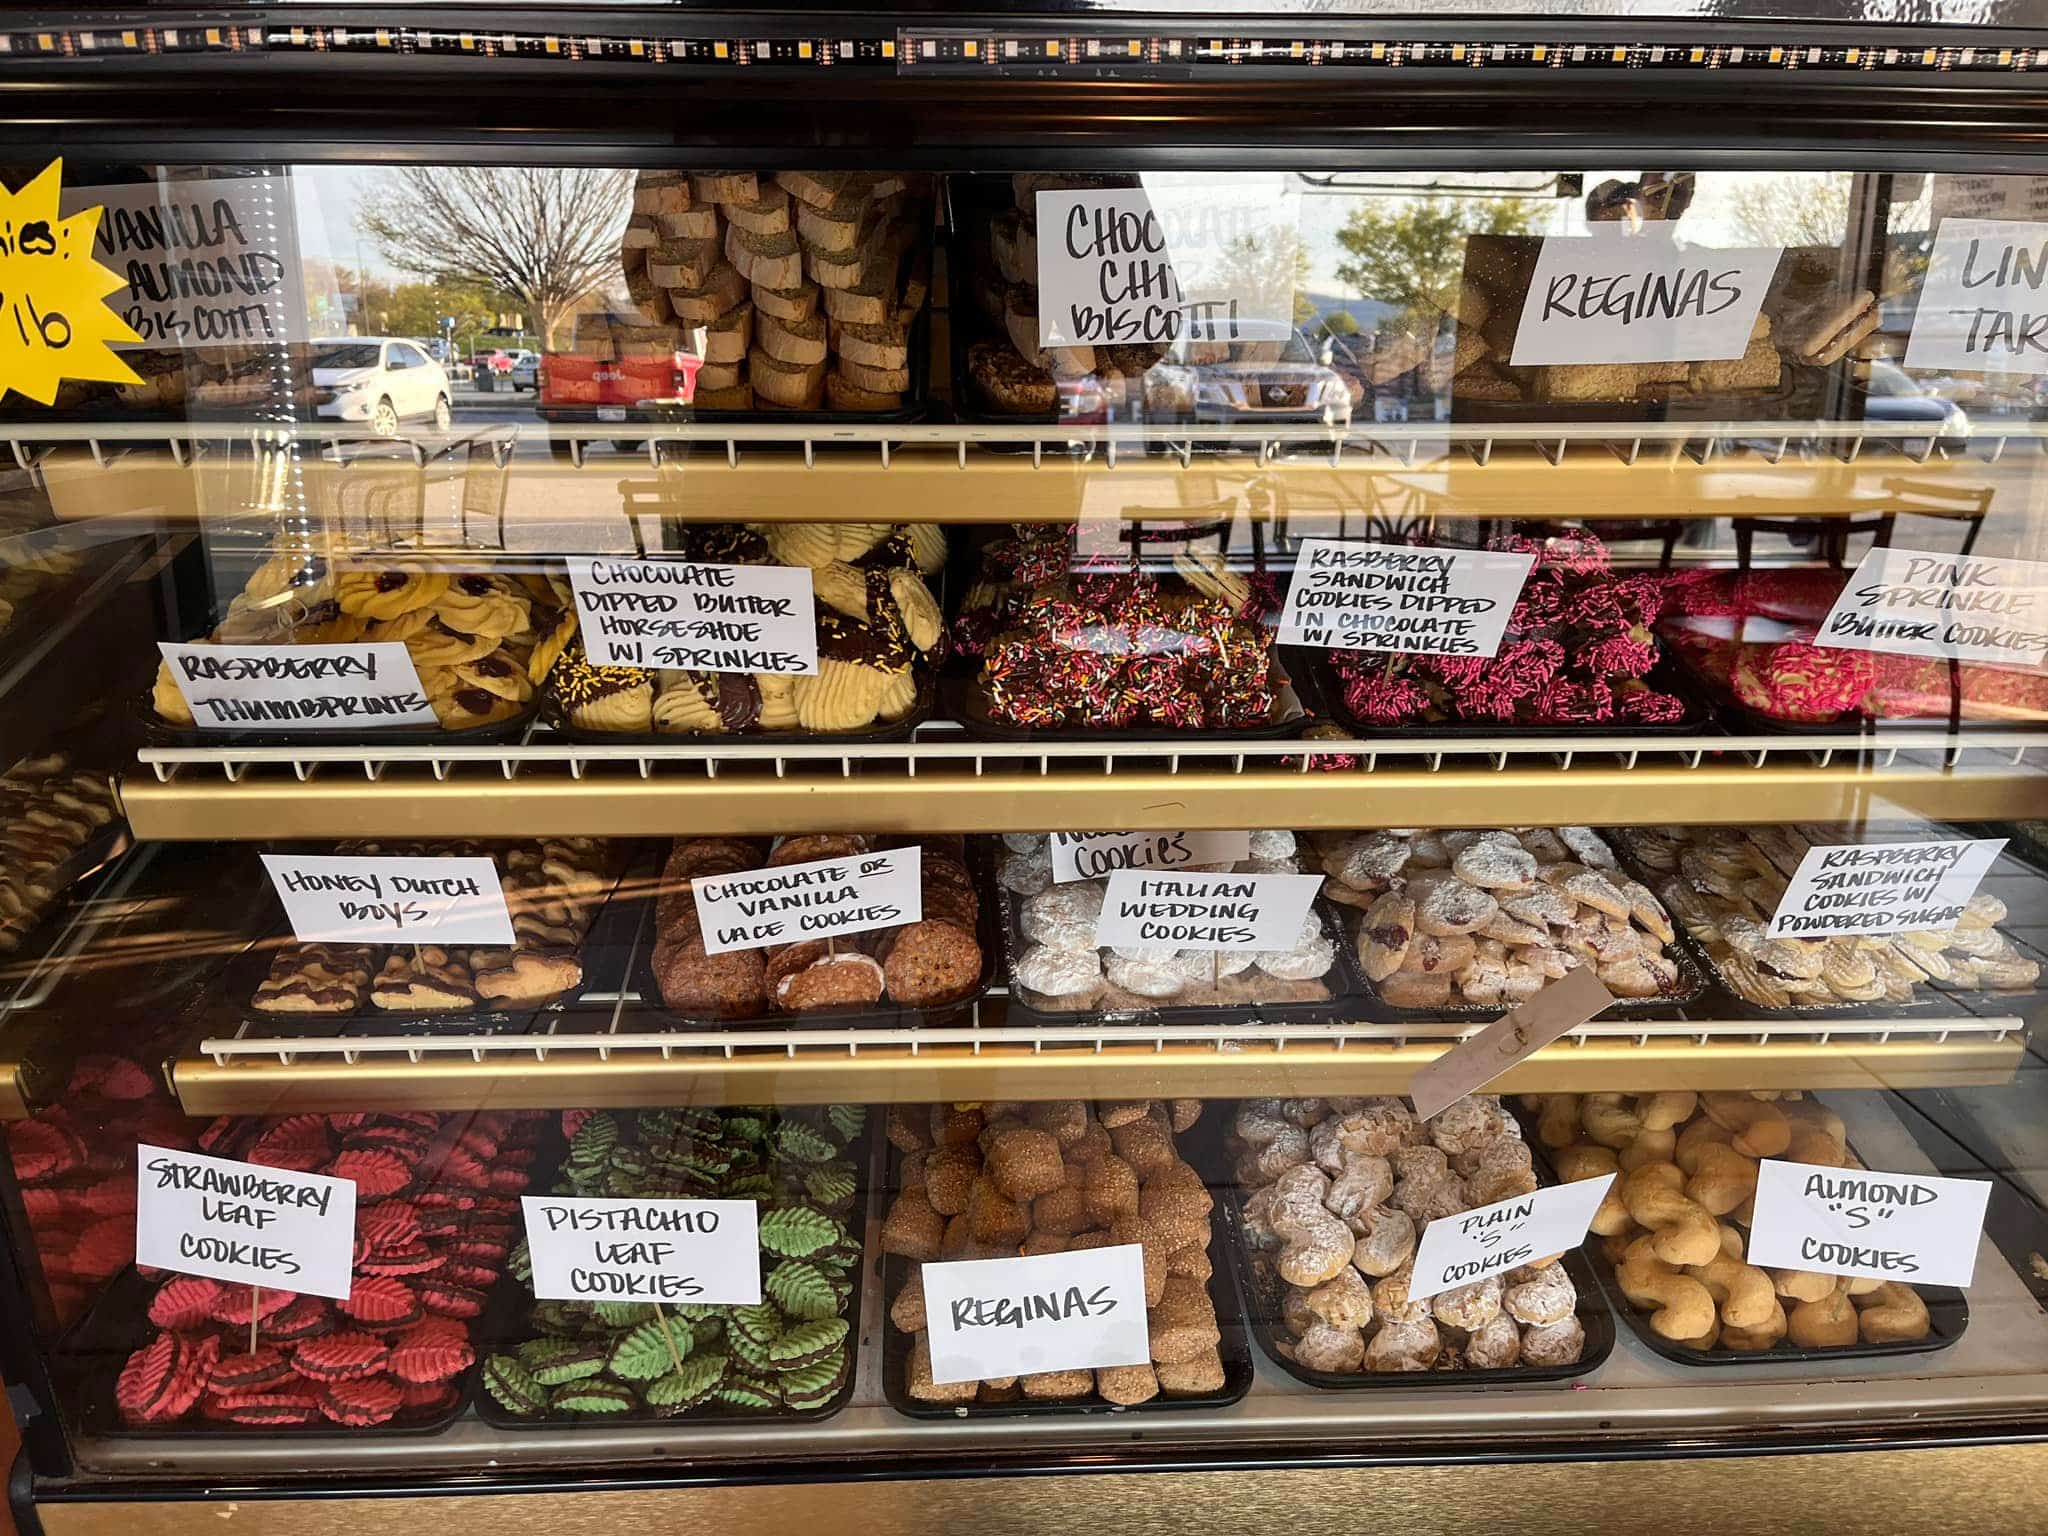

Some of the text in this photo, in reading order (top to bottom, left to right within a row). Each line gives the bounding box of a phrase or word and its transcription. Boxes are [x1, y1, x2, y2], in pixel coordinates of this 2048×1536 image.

[126, 252, 284, 301] ALMOND
[1542, 268, 1742, 325] REGINAS
[1071, 299, 1239, 341] BISCOTTI
[592, 561, 735, 587] CHOCOLATE
[1309, 571, 1451, 594] SANDWICH
[1904, 557, 1999, 587] PINK
[579, 590, 796, 617] DIPPED BUTTER
[1295, 588, 1497, 614] COOKIES DIPPED
[1855, 584, 2034, 615] SPRINKLE
[599, 615, 762, 642] HORSESHOE
[1295, 611, 1477, 635] IN CHOCOLATE
[1943, 622, 2048, 651] COOKIES
[1342, 632, 1479, 654] SPRINKLES
[177, 652, 378, 682] RASPBERRY
[652, 646, 809, 672] SPRINKLES
[193, 692, 431, 722] THUMBPRINTS
[281, 870, 482, 900] HONEY DUTCH
[703, 858, 894, 903] CHOCOLATE OR
[1140, 880, 1257, 898] ITALIAN
[1810, 865, 1947, 891] SANDWICH
[737, 885, 860, 918] VANILLA
[1119, 902, 1260, 922] WEDDING
[1803, 889, 1898, 912] COOKIES
[716, 904, 901, 946] LACE COOKIES
[1140, 922, 1257, 943] COOKIES
[1777, 906, 1965, 934] POWDERED SUGAR
[147, 1158, 332, 1217] STRAWBERRY
[1804, 1174, 1938, 1206] ALMOND
[202, 1196, 277, 1230] LEAF
[540, 1206, 720, 1234] PISTACHIO
[1459, 1198, 1534, 1234] PLAIN
[180, 1232, 301, 1275] COOKIES
[595, 1241, 675, 1266] LEAF
[1442, 1243, 1533, 1284] COOKIES
[1801, 1237, 1920, 1273] COOKIES
[570, 1268, 705, 1298] COOKIES
[951, 1285, 1118, 1332] REGINAS
